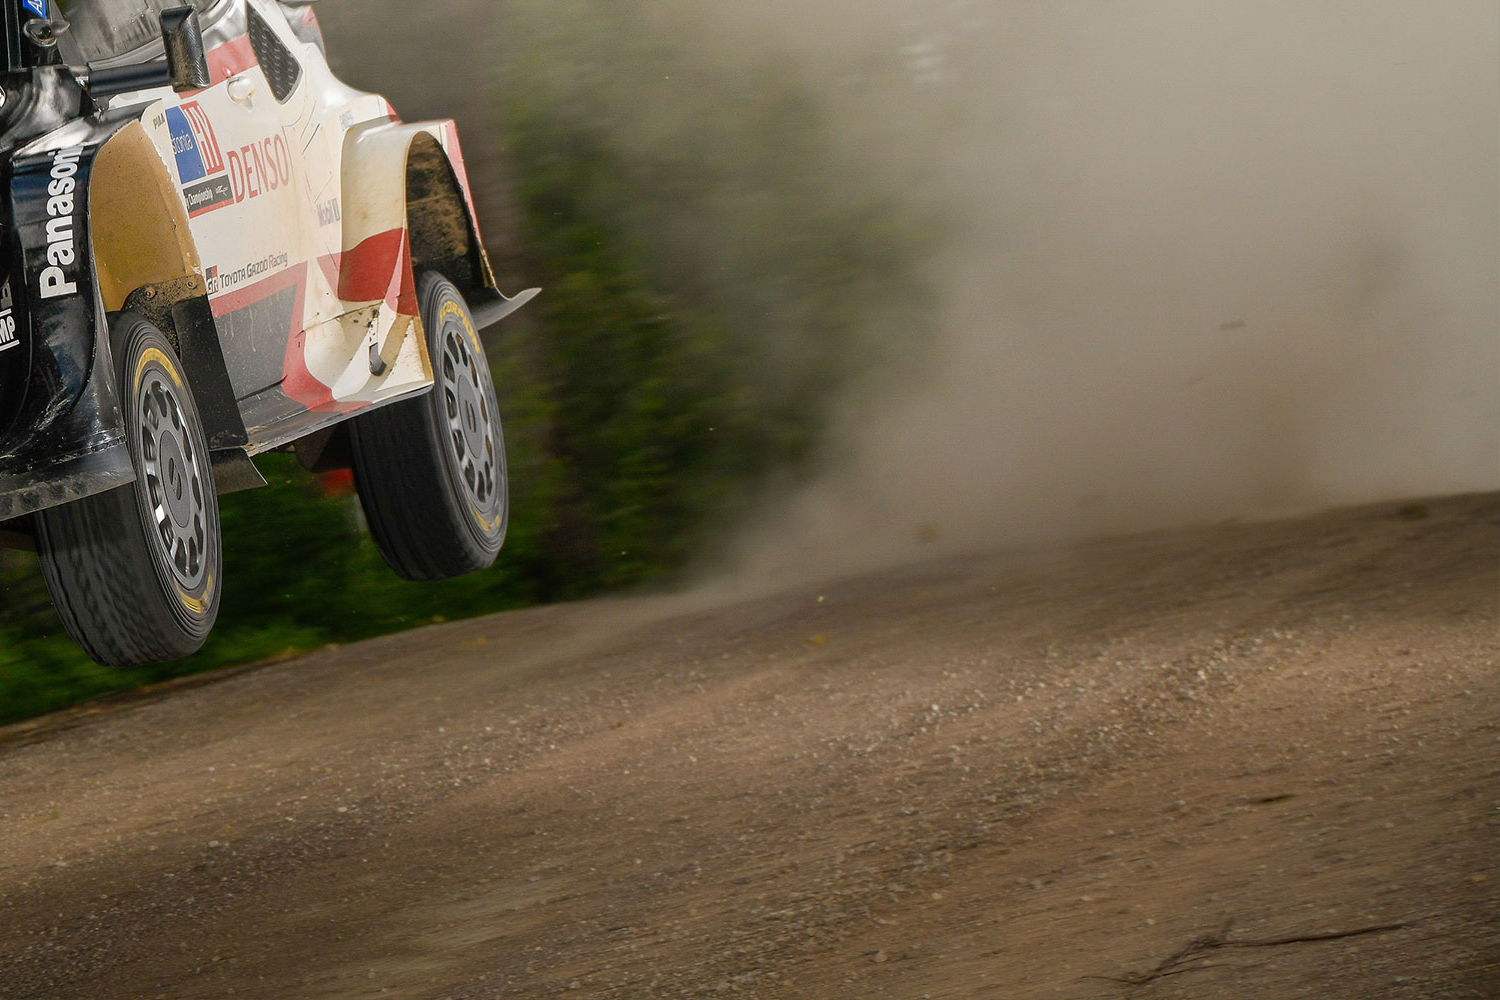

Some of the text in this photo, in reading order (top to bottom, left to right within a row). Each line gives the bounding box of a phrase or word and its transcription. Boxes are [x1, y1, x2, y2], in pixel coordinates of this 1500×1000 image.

[227, 133, 290, 204] DENSO
[220, 250, 289, 289] TOYOTA GAZOO Racing
